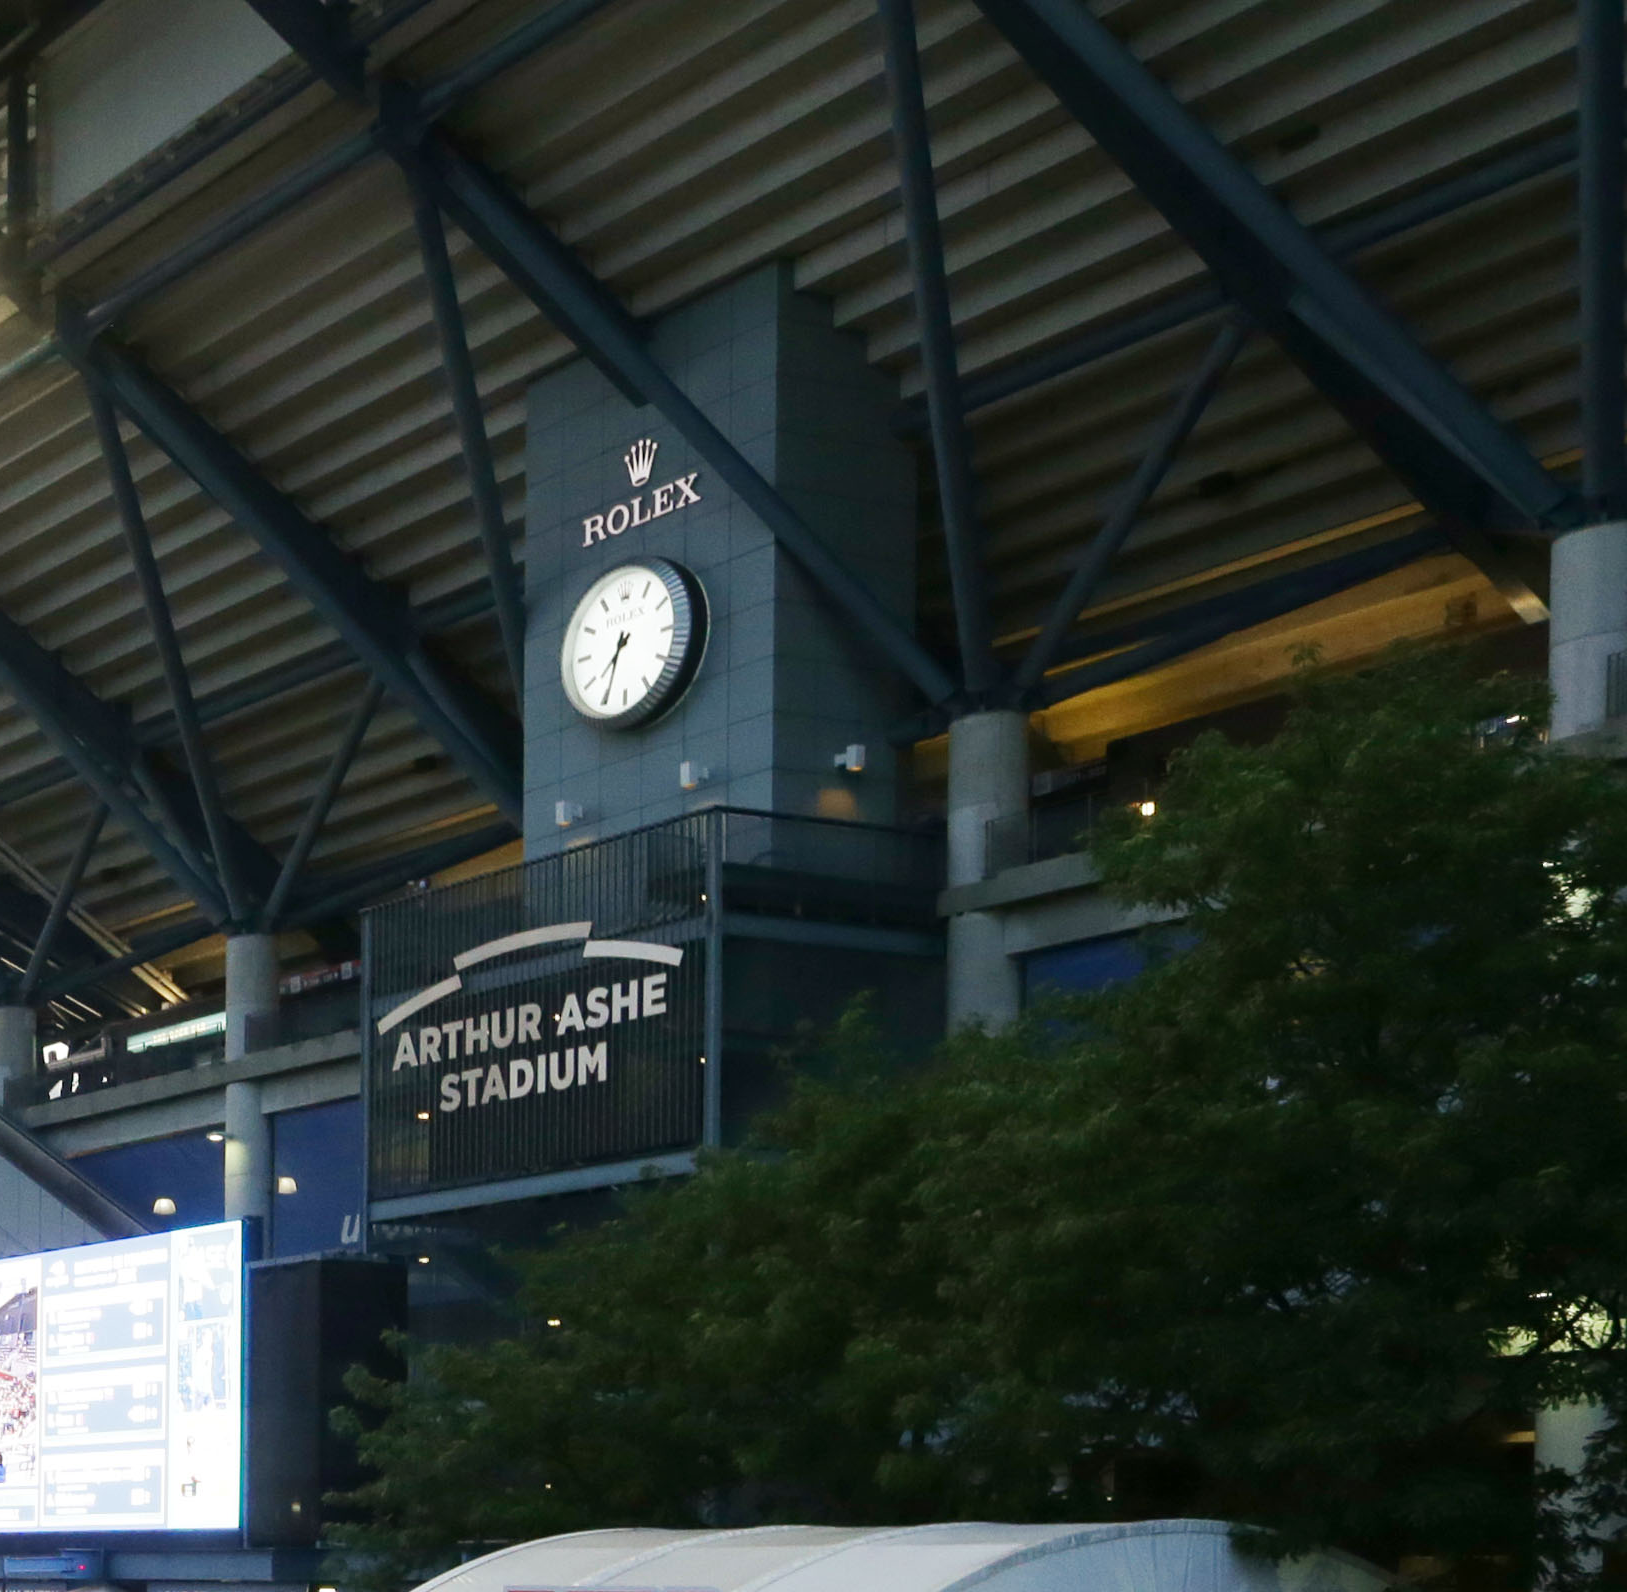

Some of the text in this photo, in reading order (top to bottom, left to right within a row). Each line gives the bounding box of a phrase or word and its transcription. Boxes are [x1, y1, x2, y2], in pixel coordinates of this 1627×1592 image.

[581, 472, 702, 548] ROLEX
[605, 606, 646, 629] ROLEX
[392, 972, 667, 1071] ARTHUR ASHE
[439, 1041, 607, 1112] STADIUM
